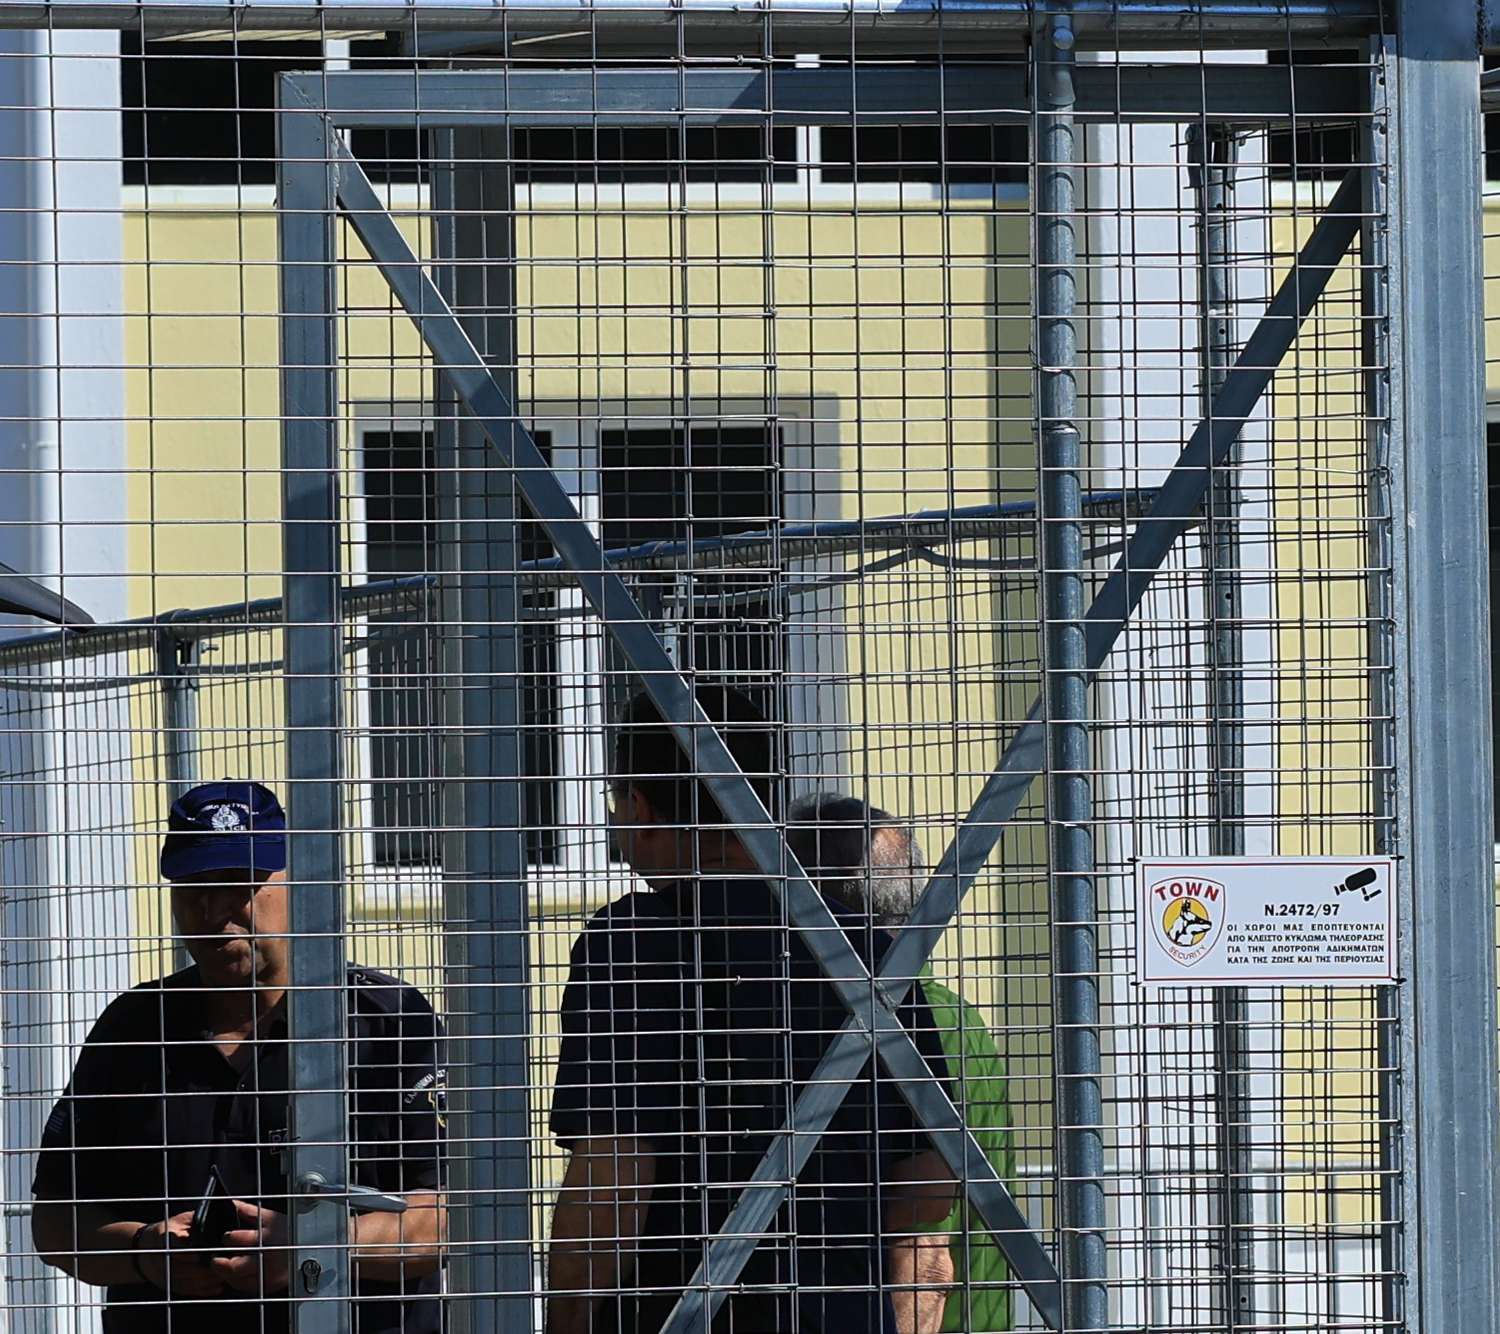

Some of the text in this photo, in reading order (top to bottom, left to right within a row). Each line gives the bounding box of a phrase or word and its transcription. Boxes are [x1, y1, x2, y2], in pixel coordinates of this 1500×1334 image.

[1155, 881, 1219, 902] TOWN
[1264, 904, 1340, 918] Ν.2472/97
[1311, 923, 1384, 931] ΕΠΟΠΤΕΥΟΝΤΑΙ
[1285, 934, 1327, 942] ΚΥΚΛΩΜΑ
[1168, 944, 1207, 960] SECURITY
[1247, 945, 1265, 953] ΤΗΝ
[1326, 944, 1384, 952] ΑΔΙΚΗΜΑΤΩΝ
[1227, 956, 1249, 964] ΚΑΤΑ
[1252, 956, 1267, 964] ΤΗΣ
[1334, 955, 1384, 963] ΠΕΡΙΟΥΣΙΑΣ
